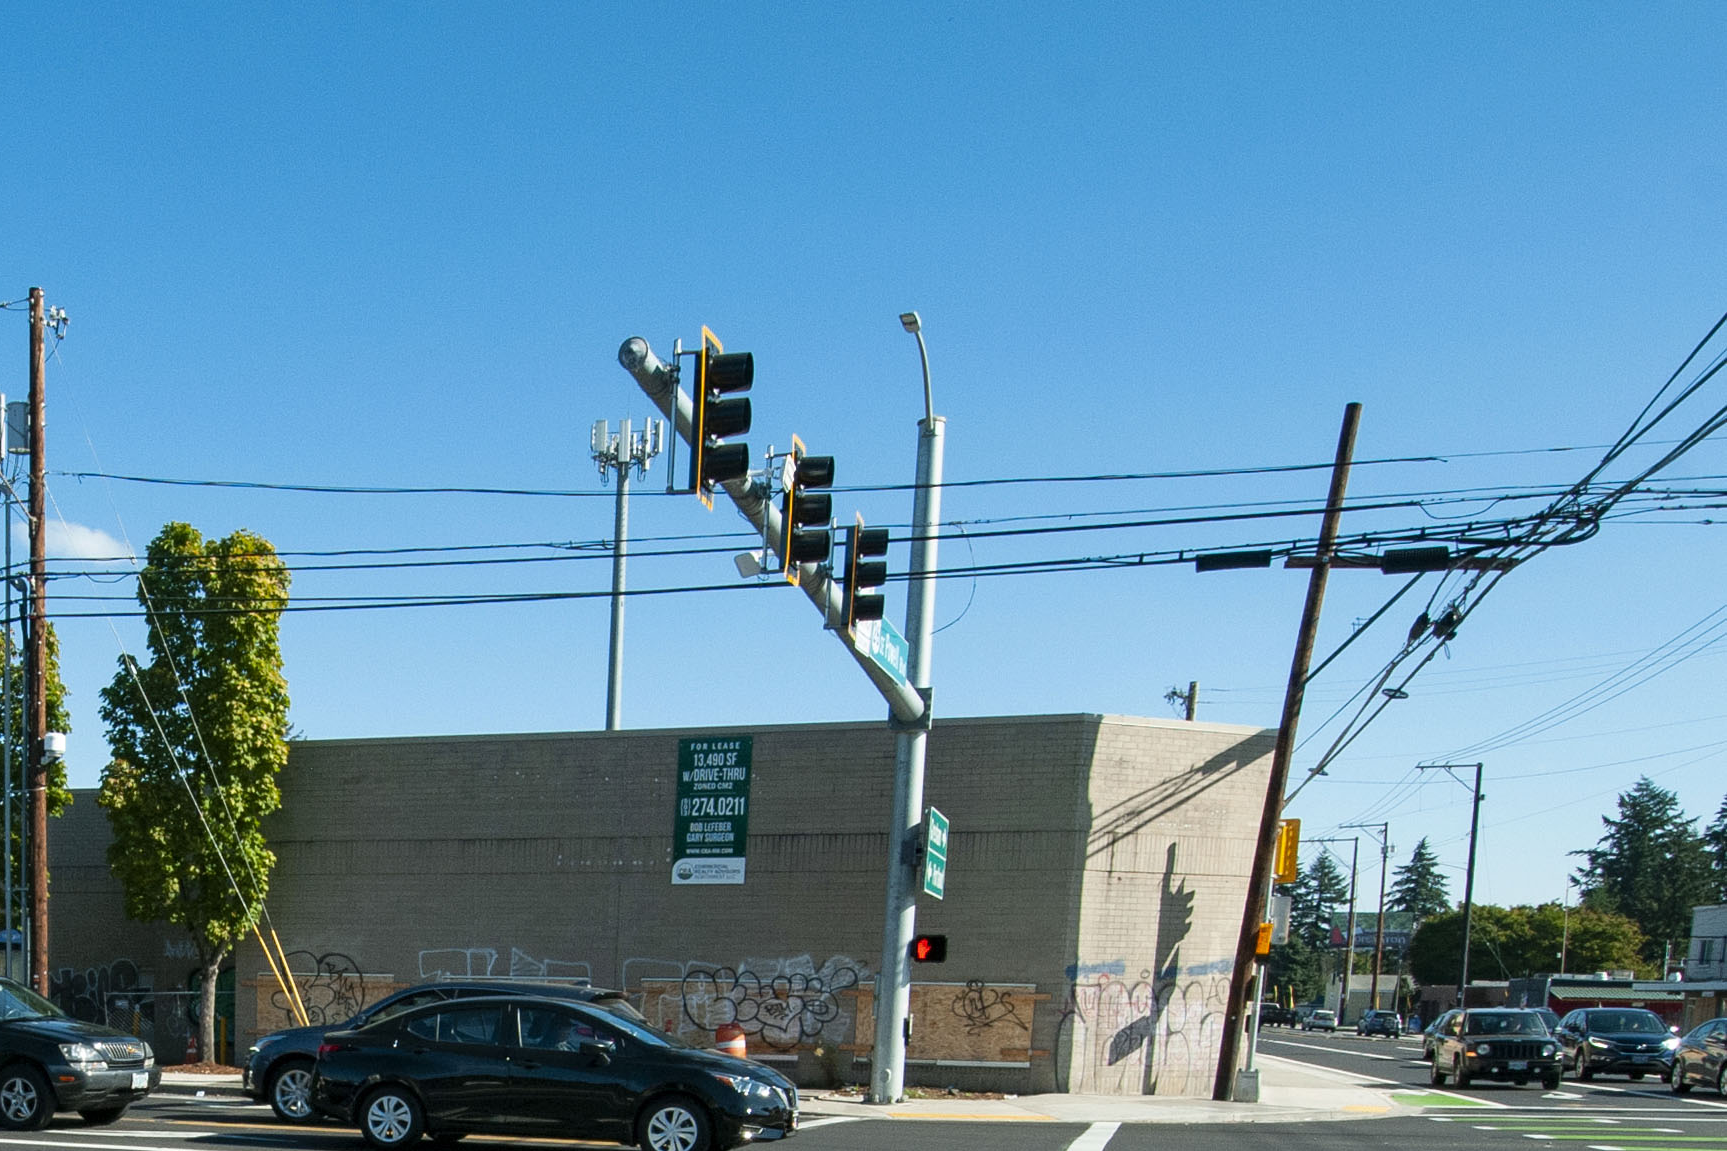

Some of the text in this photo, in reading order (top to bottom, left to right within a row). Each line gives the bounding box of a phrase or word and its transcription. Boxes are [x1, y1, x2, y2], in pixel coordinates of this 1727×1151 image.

[712, 742, 741, 750] LEASE
[694, 752, 738, 768] 13,490 SF
[682, 767, 746, 782] W/DRIVE-THRU
[692, 797, 745, 816] 274.0211
